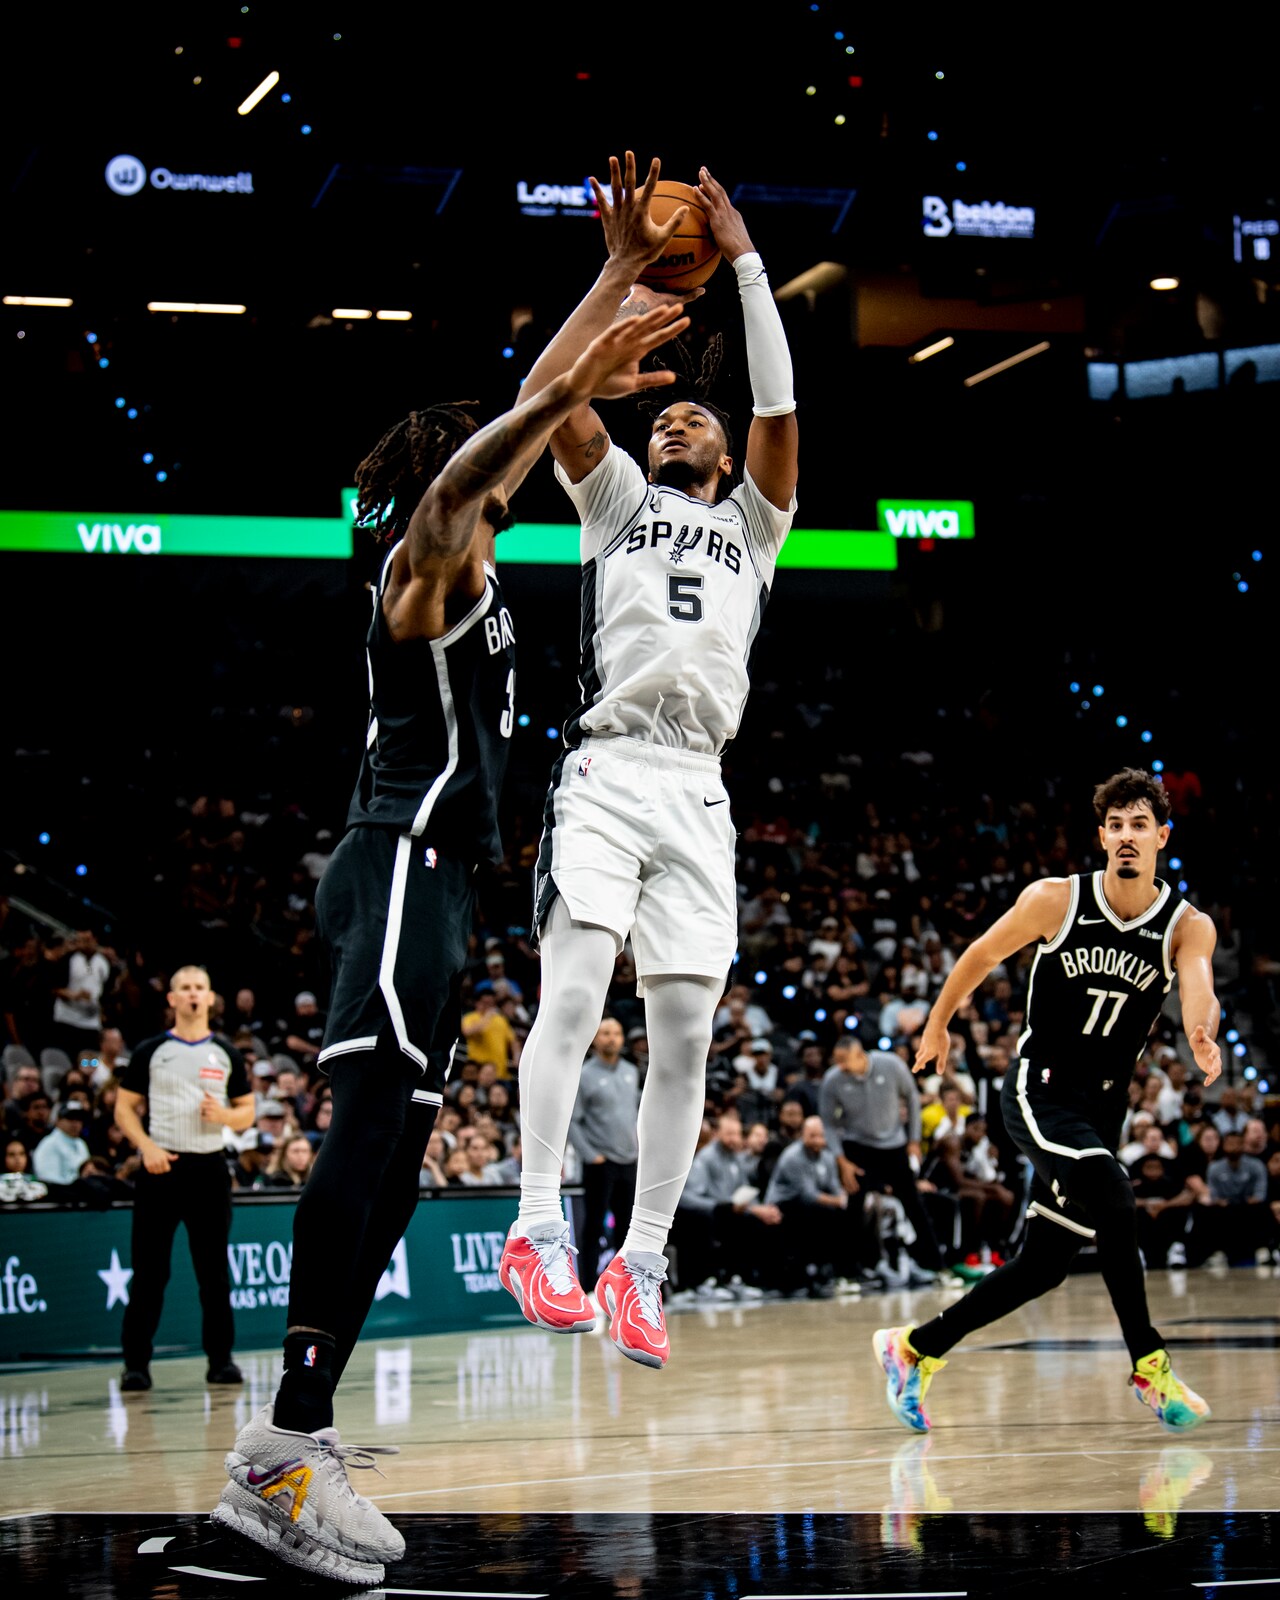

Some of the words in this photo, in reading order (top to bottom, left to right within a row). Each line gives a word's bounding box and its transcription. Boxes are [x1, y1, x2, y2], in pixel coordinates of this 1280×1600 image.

[150, 167, 254, 194] Ownwell
[516, 181, 587, 206] LONE
[78, 523, 162, 553] viva
[885, 509, 959, 538] viva
[626, 521, 742, 575] SPURS
[667, 573, 704, 624] 5
[1060, 946, 1160, 991] BROOKLYN
[1082, 988, 1129, 1037] 77
